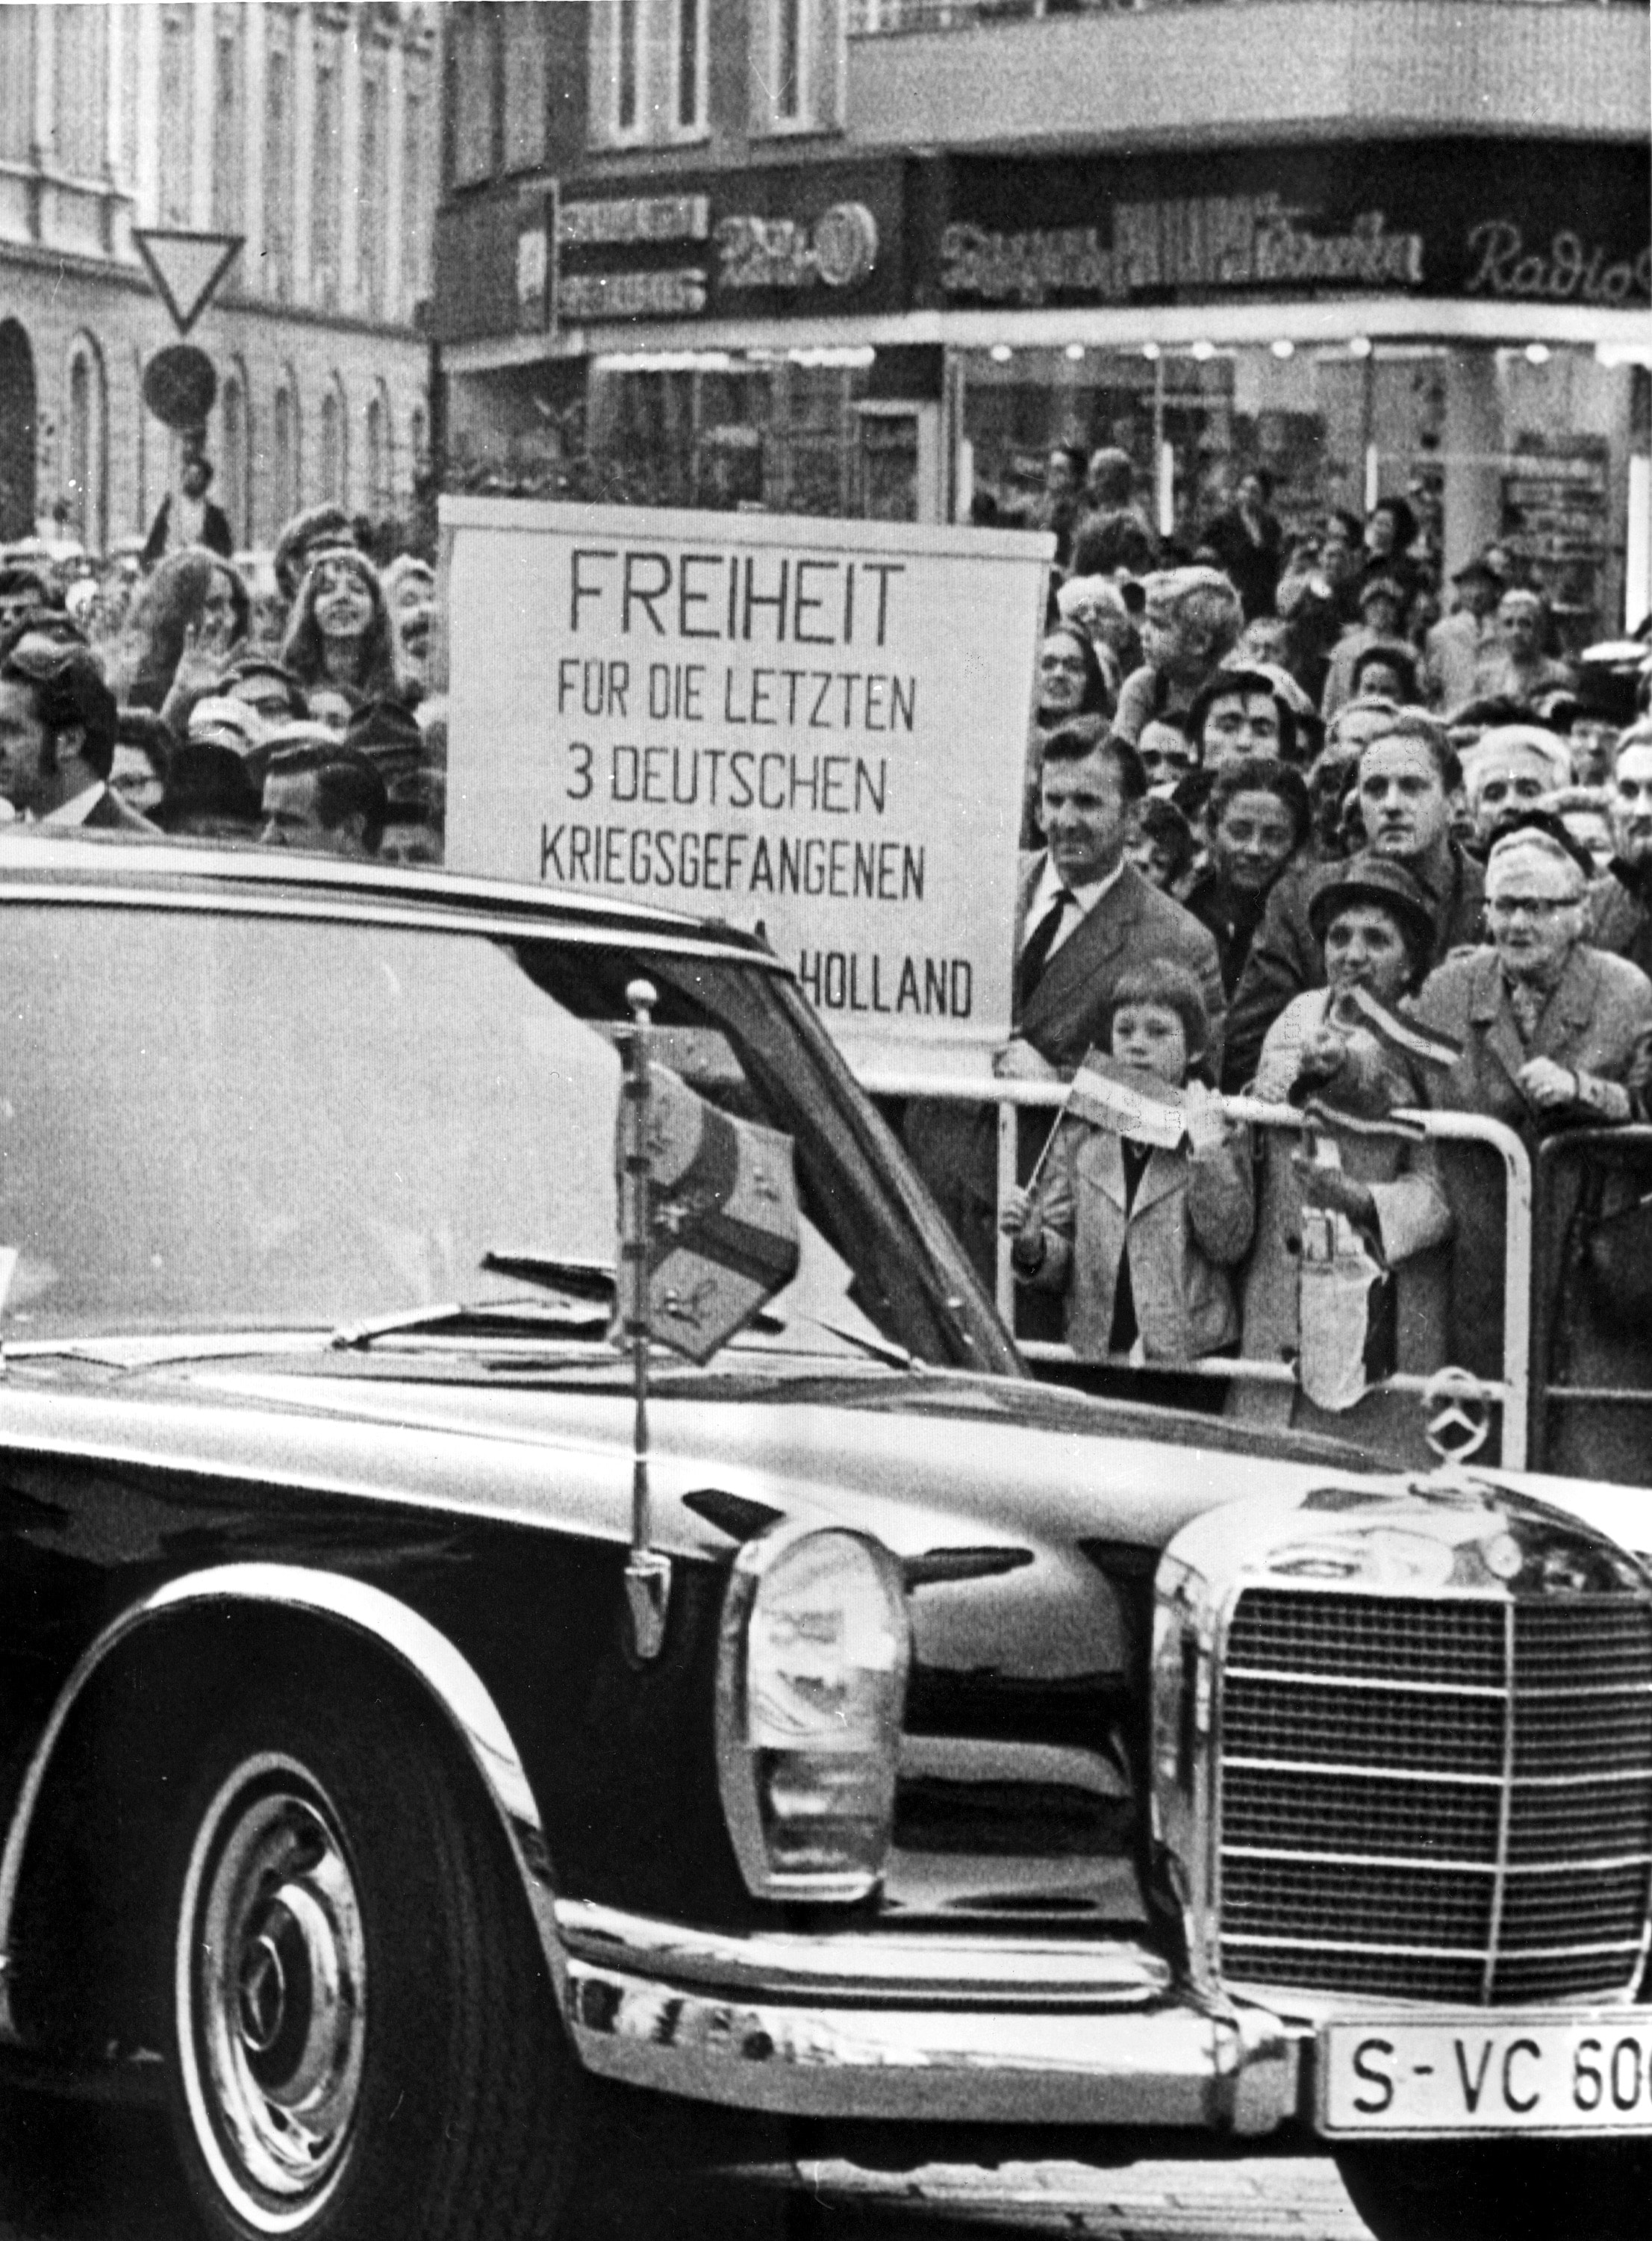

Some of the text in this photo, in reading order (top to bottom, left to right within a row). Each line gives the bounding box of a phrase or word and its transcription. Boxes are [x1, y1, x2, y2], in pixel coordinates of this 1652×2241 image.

[1466, 221, 1632, 299] Radio
[571, 549, 906, 646] FREIHEIT
[649, 662, 705, 721] DIE
[725, 666, 915, 732] LETZTEN
[566, 741, 887, 814] 3 DEUTSCHEN
[540, 823, 925, 901] KRIEGSGEFANGENEN
[799, 949, 972, 1018] HOLLAND
[1572, 2036, 1652, 2113] 60
